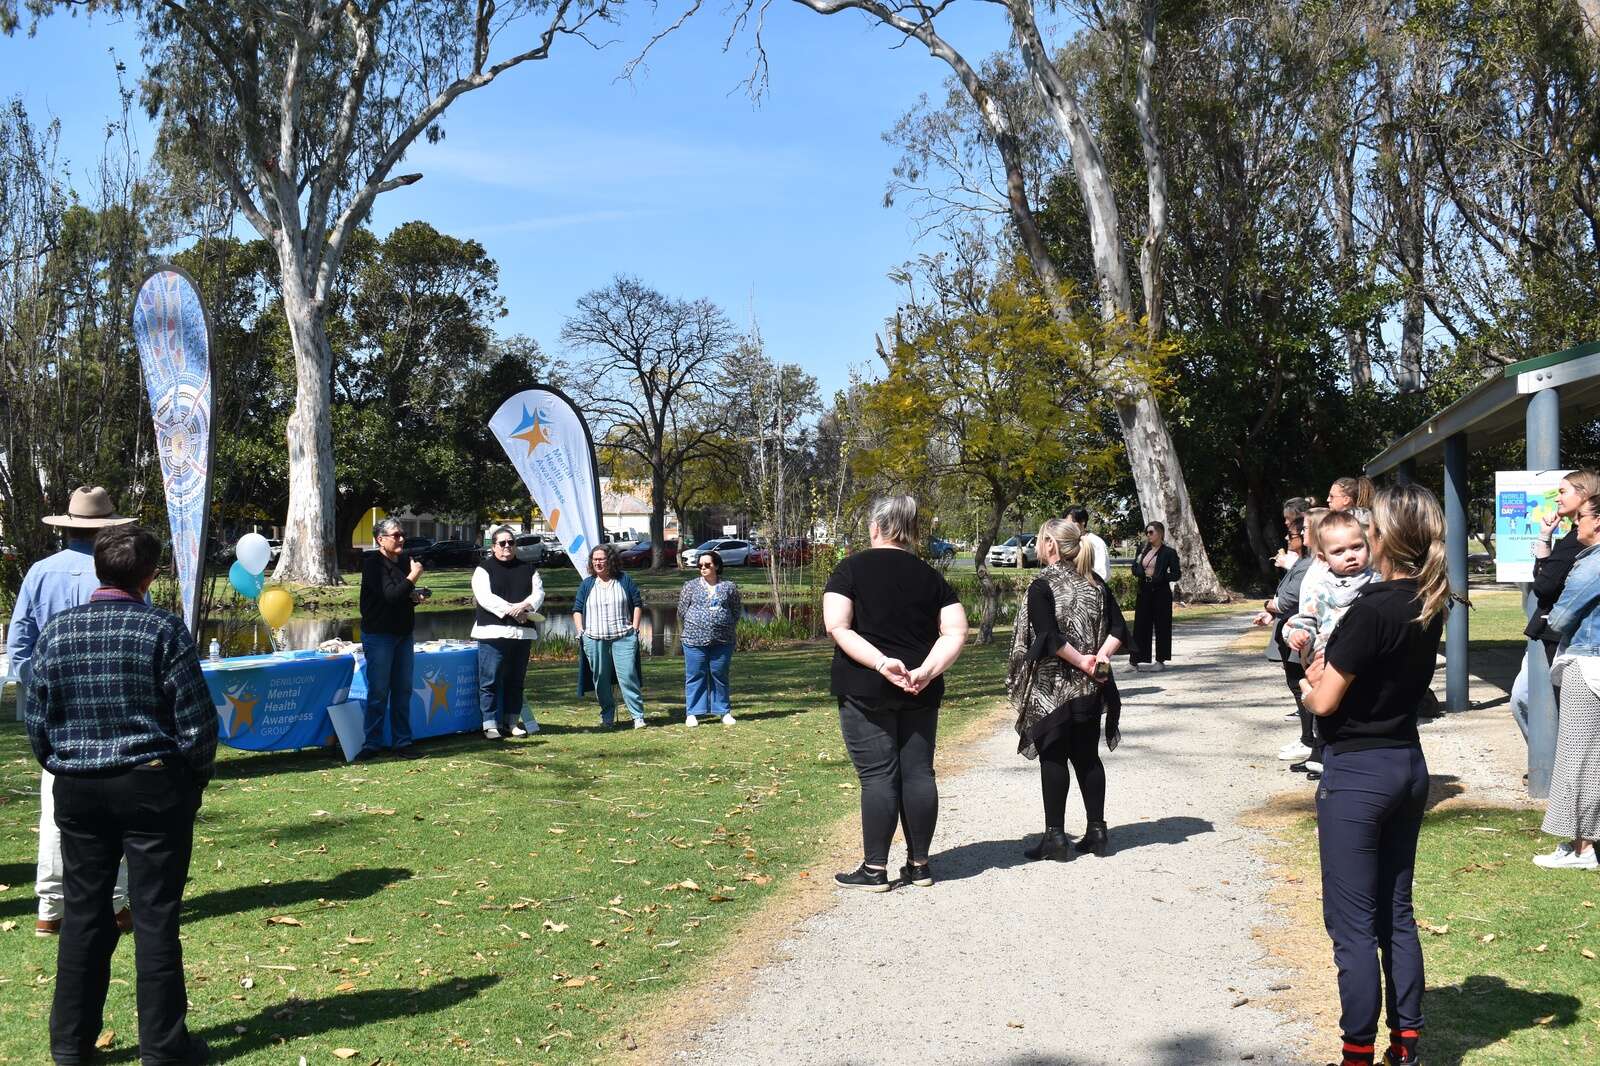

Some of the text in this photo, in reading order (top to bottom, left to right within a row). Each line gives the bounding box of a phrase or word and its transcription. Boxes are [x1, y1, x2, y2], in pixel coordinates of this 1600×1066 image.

[544, 453, 564, 482] Health
[551, 448, 574, 479] Mental
[535, 459, 565, 504] Awareness
[264, 701, 297, 712] Health
[267, 686, 301, 699] Mental
